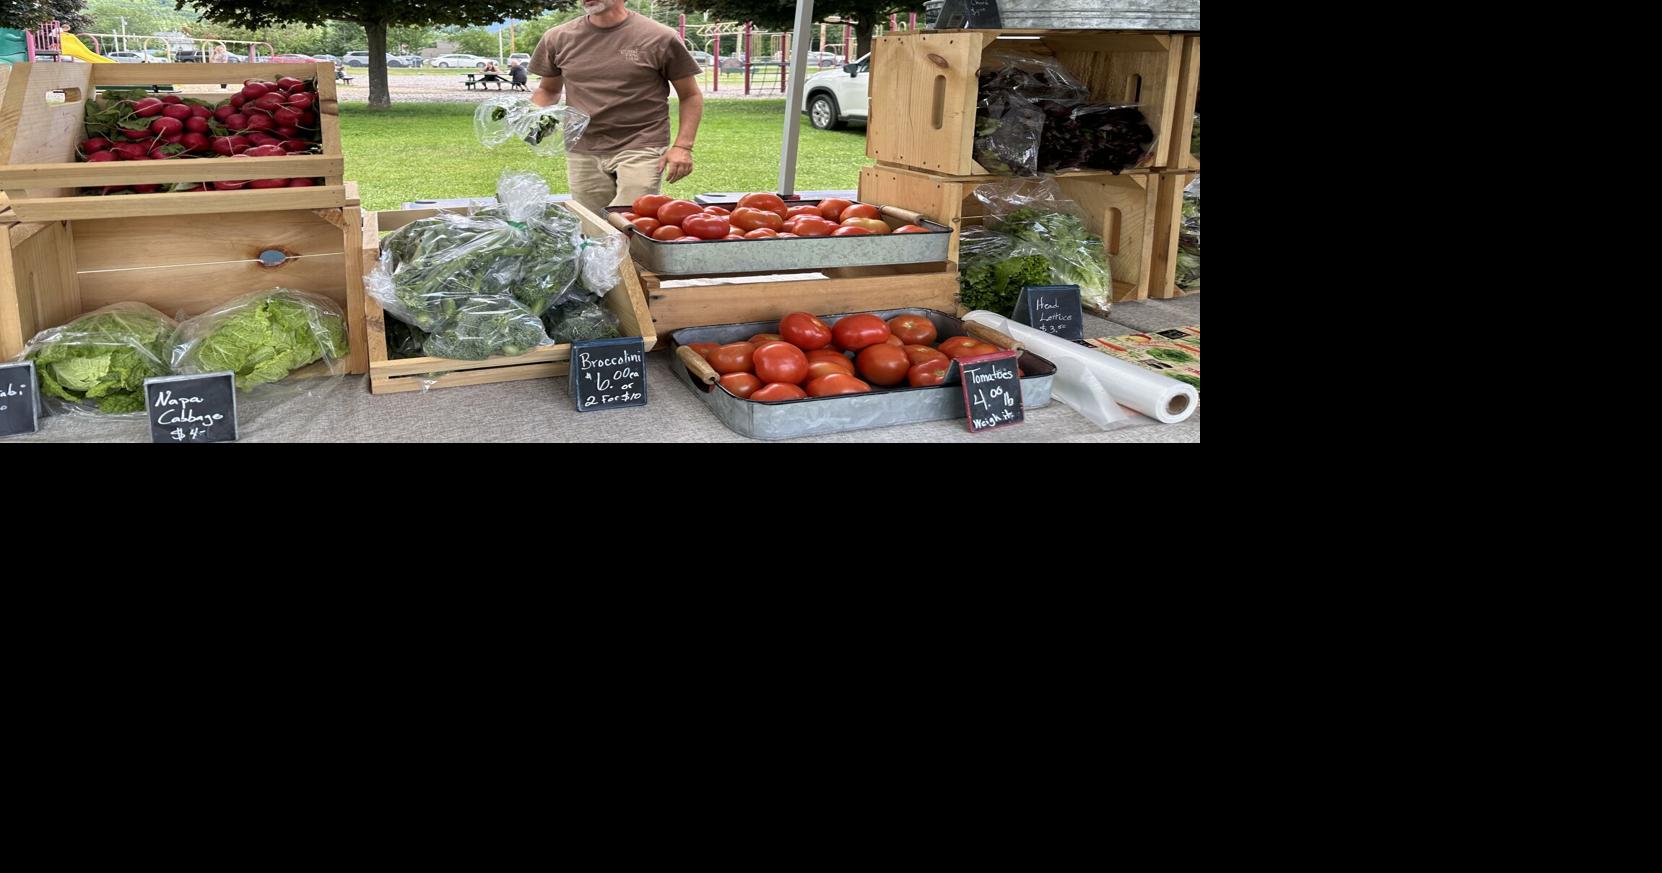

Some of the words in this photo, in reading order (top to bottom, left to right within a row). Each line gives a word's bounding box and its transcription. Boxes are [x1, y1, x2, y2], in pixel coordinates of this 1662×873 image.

[1036, 297, 1060, 311] Head
[579, 350, 641, 370] Broccolini
[154, 390, 204, 409] Napa
[584, 395, 598, 407] 2
